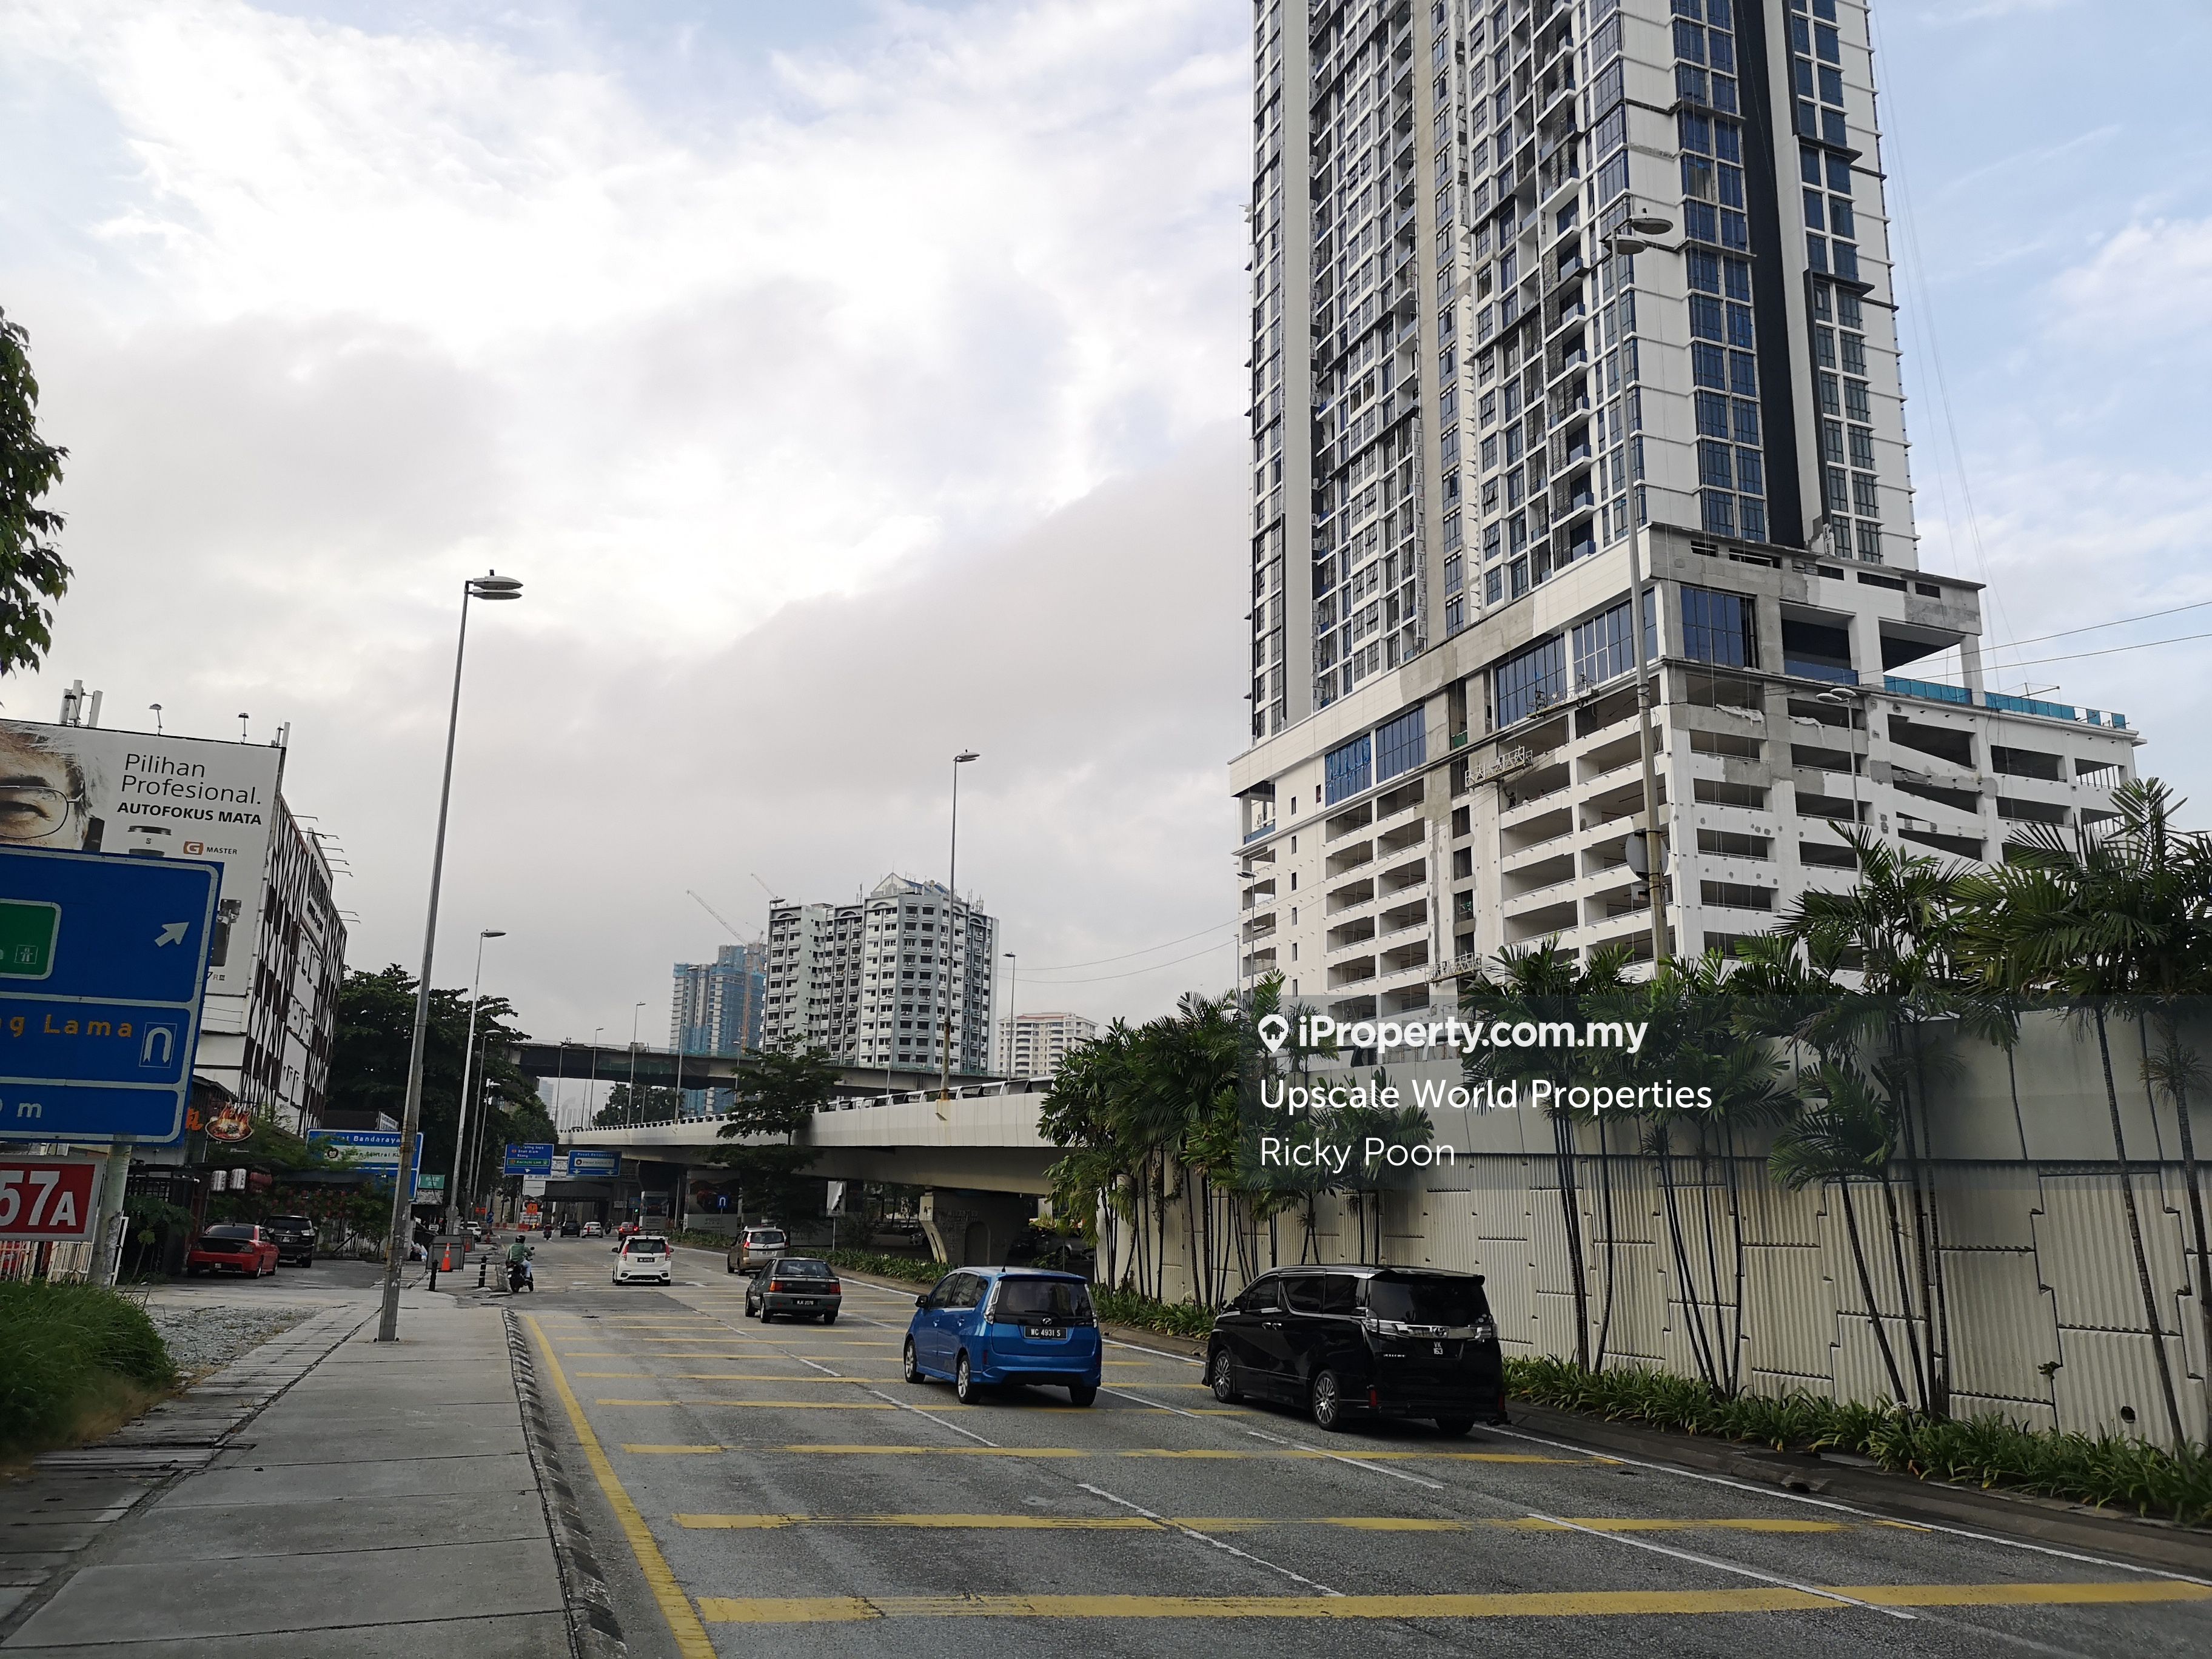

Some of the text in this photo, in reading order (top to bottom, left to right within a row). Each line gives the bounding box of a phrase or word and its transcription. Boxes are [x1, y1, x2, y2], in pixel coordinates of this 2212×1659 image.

[125, 753, 205, 778] Pilihan
[121, 774, 261, 805] Profesional.
[117, 802, 262, 825] AUTOFOKUS MATA
[206, 846, 238, 855] MASTER
[44, 1014, 133, 1038] Lama
[354, 1135, 400, 1144] Bandaraya
[1031, 1328, 1039, 1336] WC
[1041, 1329, 1054, 1337] 4931
